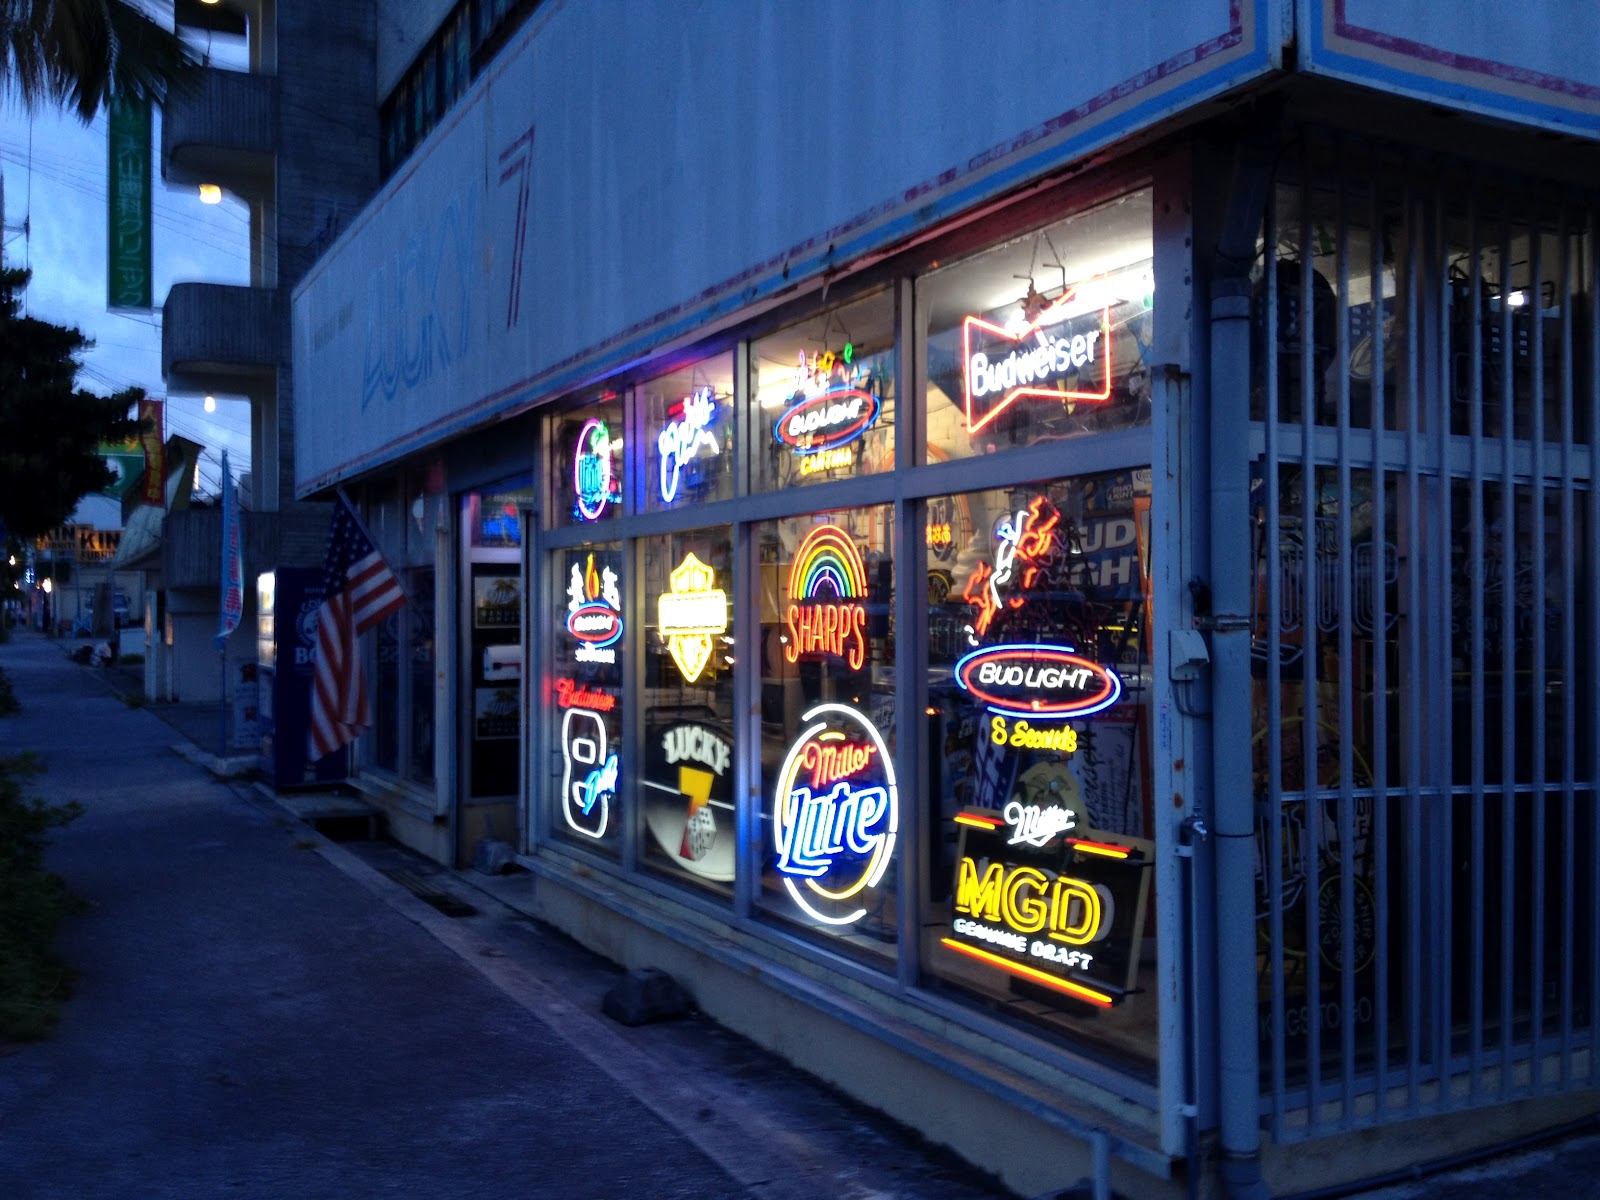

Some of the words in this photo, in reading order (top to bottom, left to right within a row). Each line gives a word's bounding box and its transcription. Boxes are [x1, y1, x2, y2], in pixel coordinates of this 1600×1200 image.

[970, 330, 1100, 397] Budweiser
[1075, 519, 1136, 553] UD
[786, 603, 867, 670] SHARP'S
[979, 663, 1023, 685] BUD
[1024, 667, 1094, 690] LIGHT
[661, 724, 731, 776] LUCKY
[803, 740, 878, 789] Miller
[778, 782, 890, 878] Lite
[956, 856, 1101, 945] MGD
[1031, 940, 1094, 970] DRAFT
